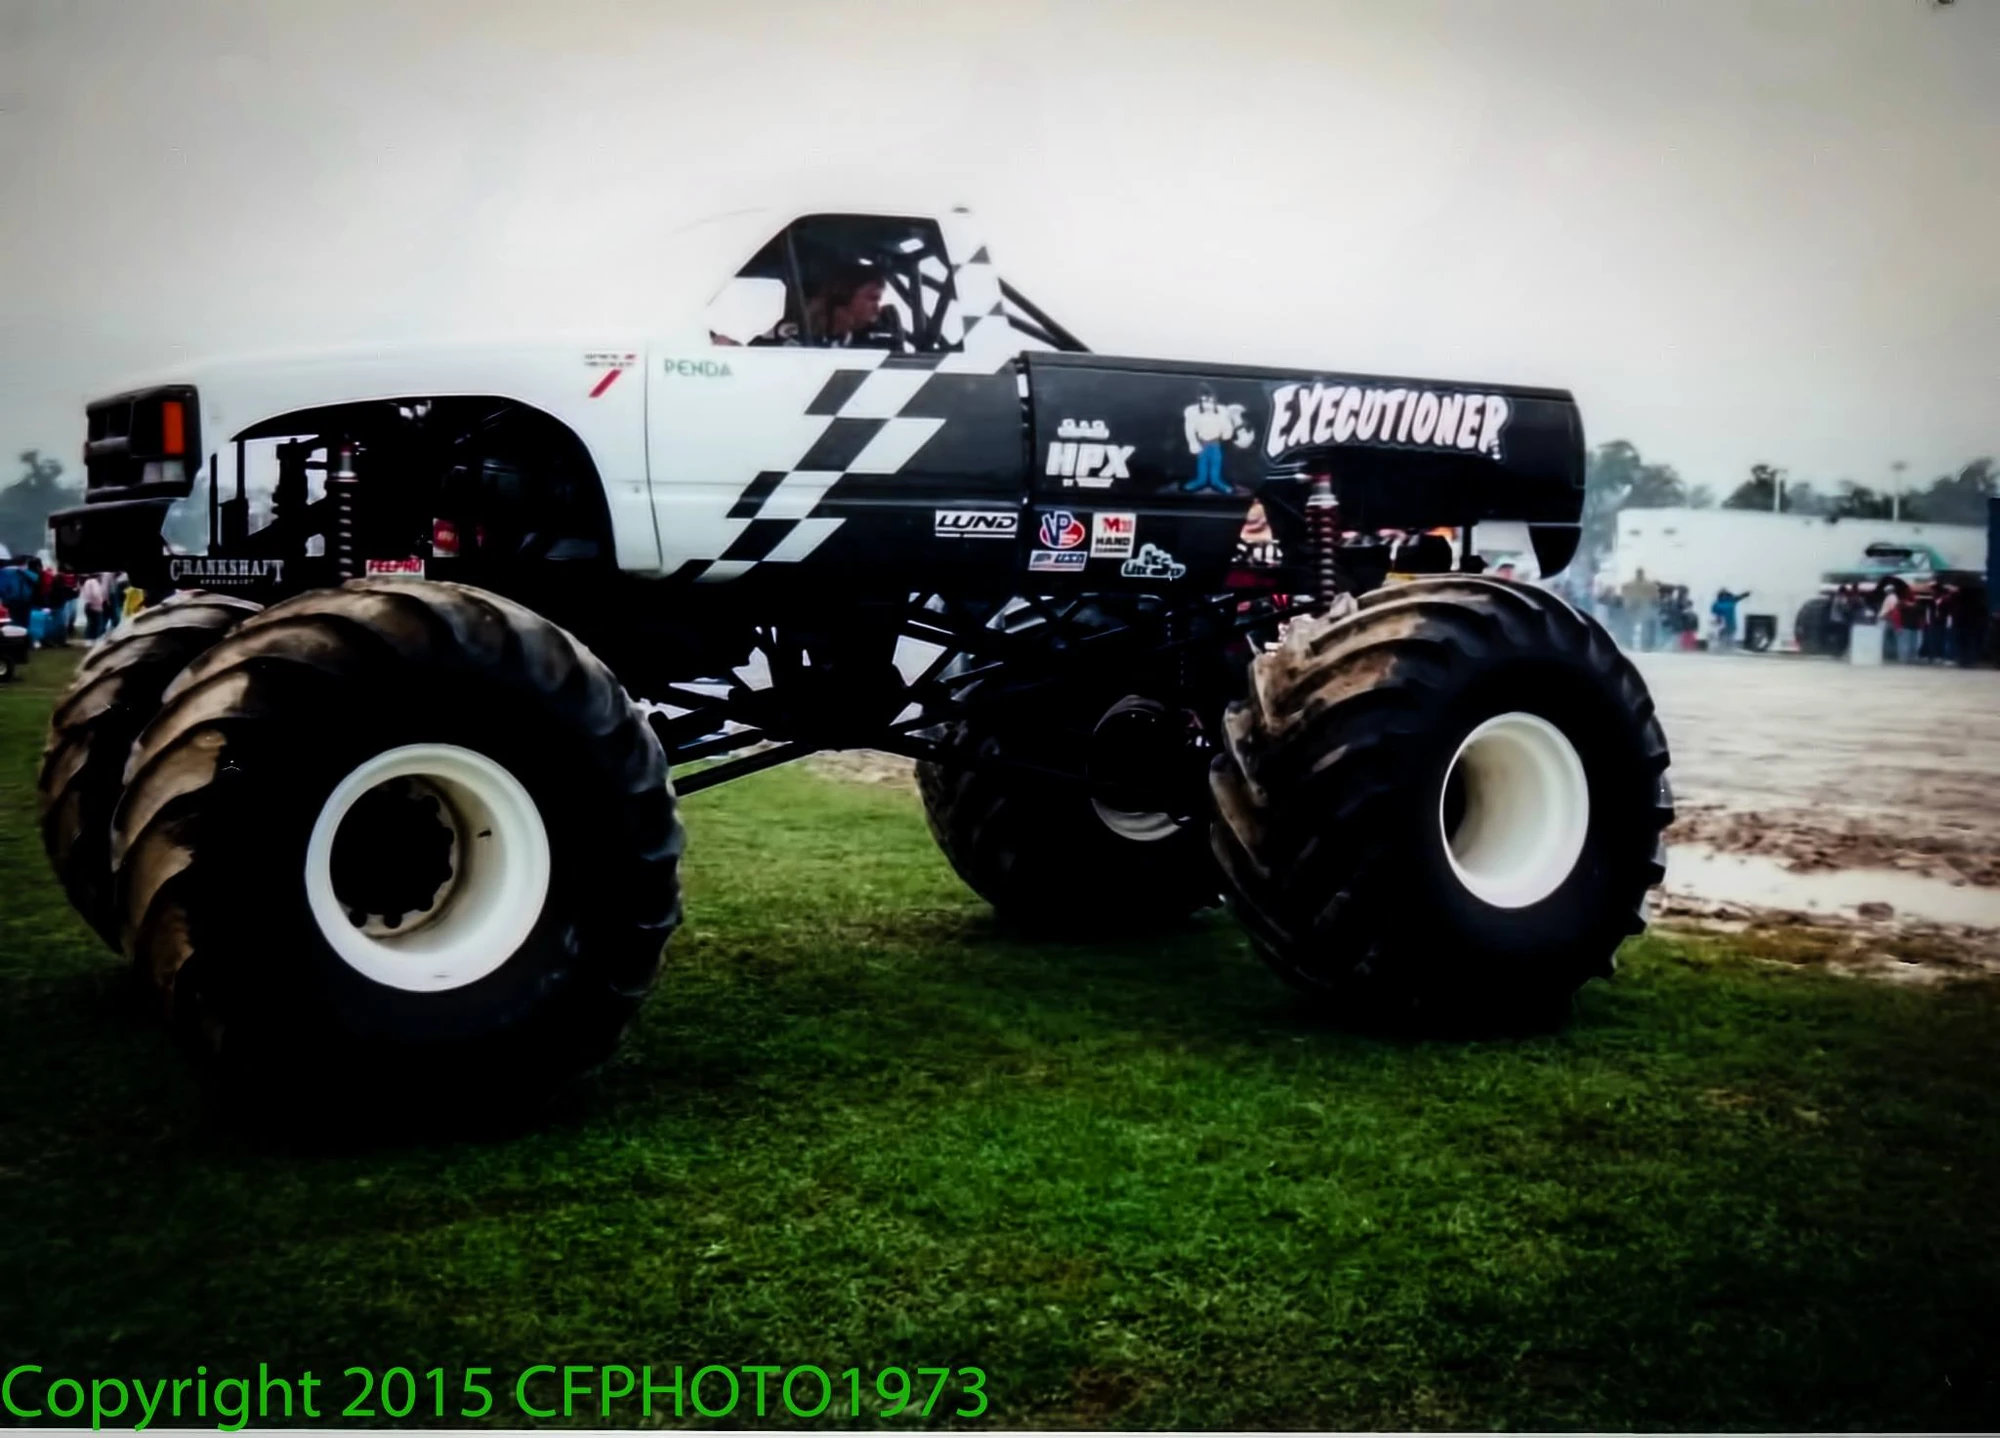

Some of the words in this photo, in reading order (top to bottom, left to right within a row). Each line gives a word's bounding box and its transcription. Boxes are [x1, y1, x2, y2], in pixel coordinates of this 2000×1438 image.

[664, 358, 733, 377] PENDA
[1267, 382, 1508, 460] EXECUTIONER
[937, 513, 1016, 530] LUND
[1042, 511, 1072, 547] VP
[169, 559, 284, 582] CRANKSHAFT
